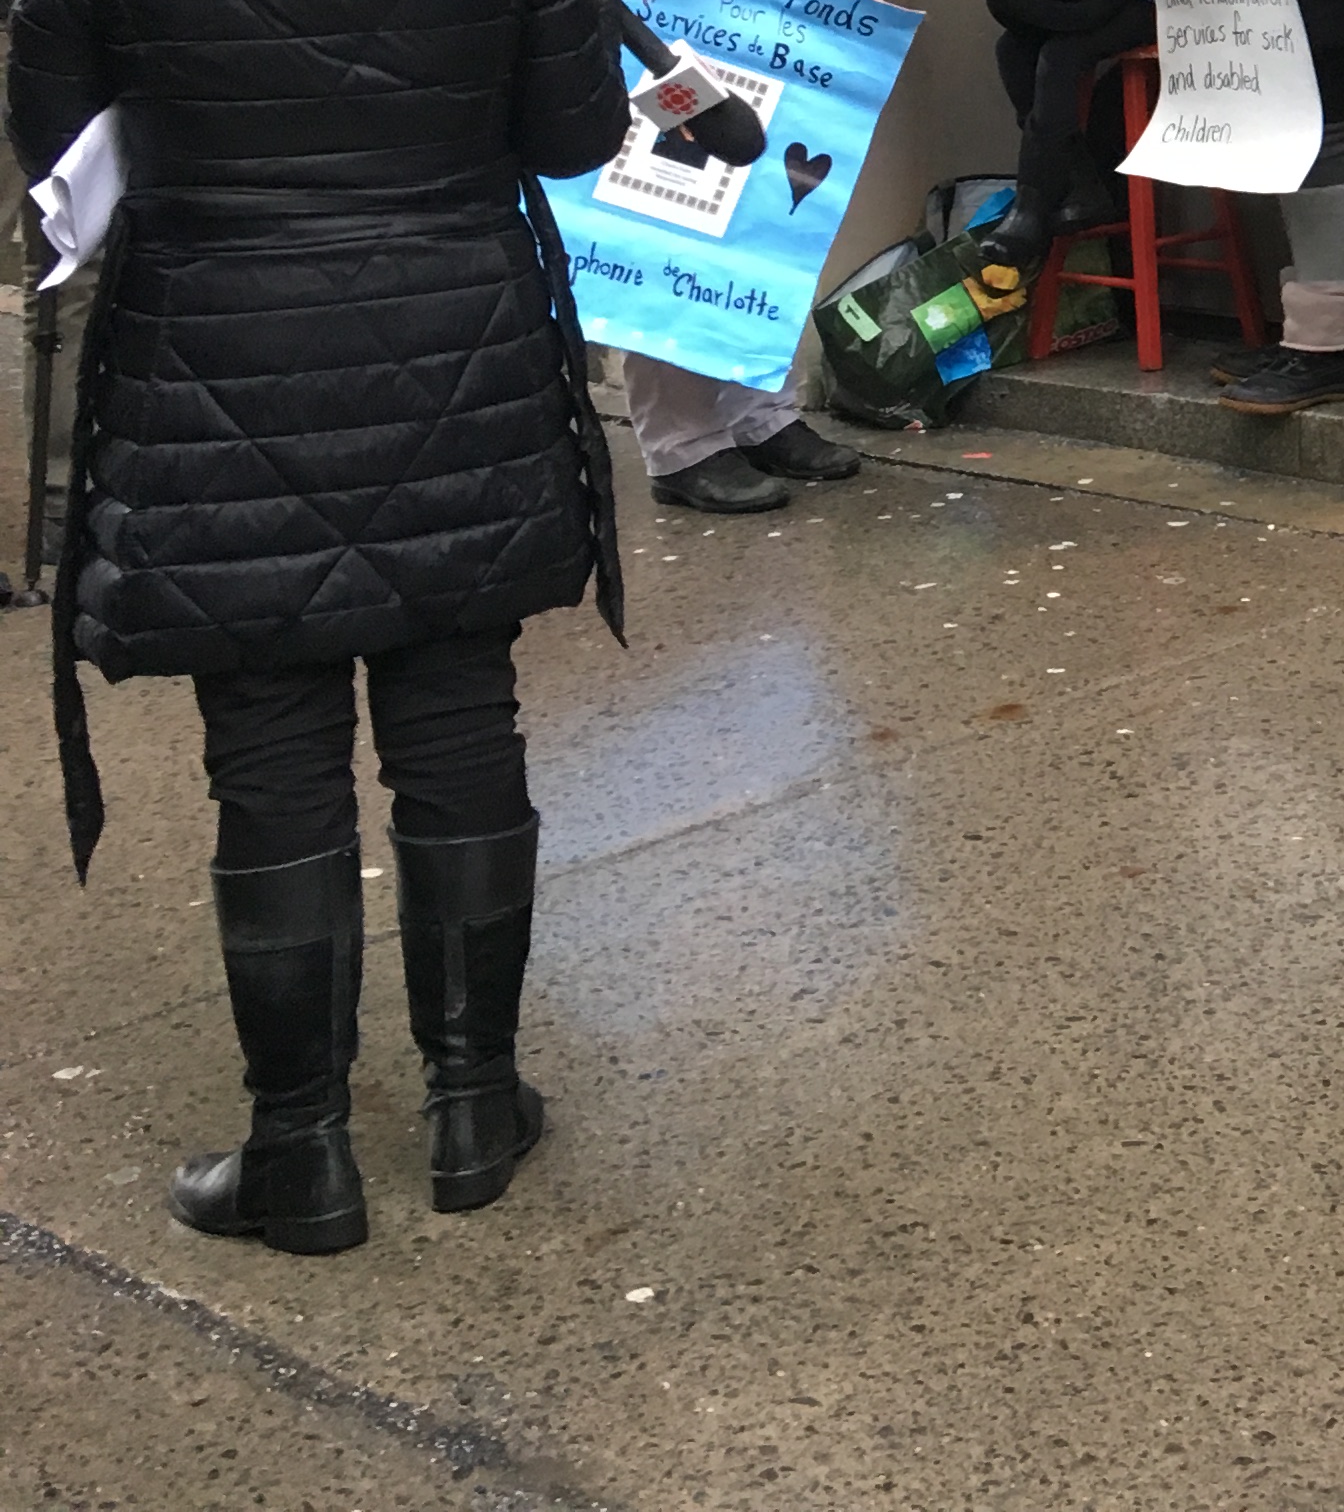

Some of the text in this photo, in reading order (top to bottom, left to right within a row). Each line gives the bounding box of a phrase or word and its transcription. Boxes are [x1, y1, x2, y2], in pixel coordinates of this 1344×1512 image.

[777, 10, 807, 44] les
[1166, 10, 1295, 54] services for sick
[748, 35, 765, 56] de
[769, 43, 834, 88] Base
[1168, 60, 1262, 96] and disabled
[1161, 114, 1232, 144] children
[663, 258, 680, 277] de
[672, 272, 779, 321] Charlotte
